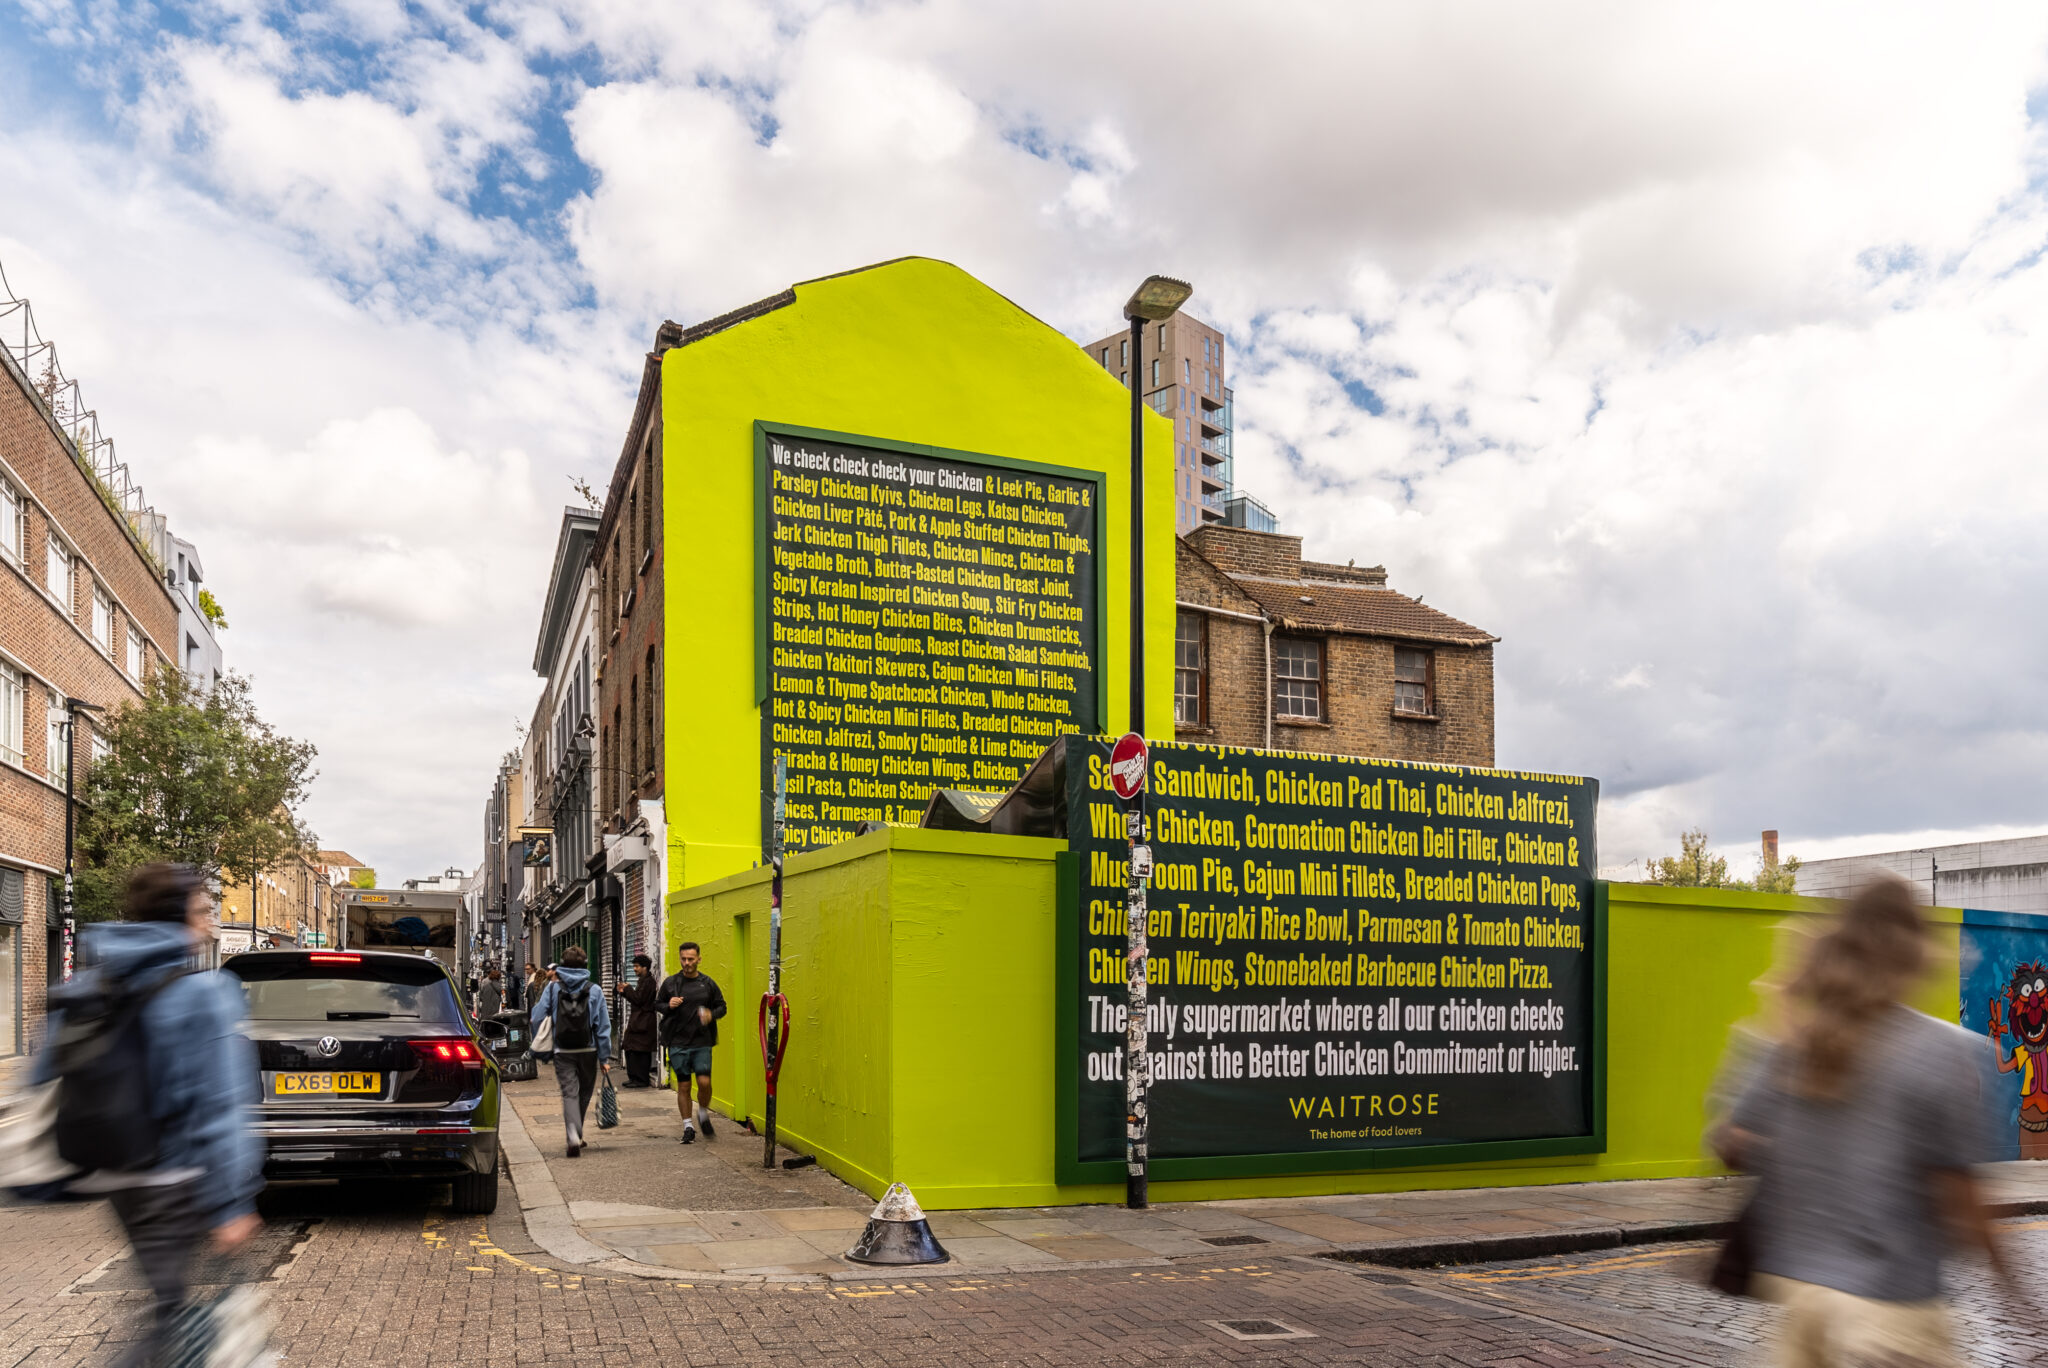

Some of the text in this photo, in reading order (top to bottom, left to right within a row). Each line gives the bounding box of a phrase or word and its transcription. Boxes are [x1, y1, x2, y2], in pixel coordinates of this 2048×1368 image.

[772, 443, 1090, 507] We check check check your Chicken & Leek Pie, Garlic &
[773, 469, 1068, 529] Parsley Chicken Kyivs, Chicken Legs, Katsu Chicken,
[773, 495, 1091, 555] Chicken Liver Pâté, Pork & Apple Stuffed Chicken Thighs,
[773, 520, 1075, 575] Jerk Chicken Thigh Fillets, Chicken Mince, Chicken &
[773, 545, 1073, 599] Vegetable Broth, Butter-Basted Chicken Breast Joint,
[773, 571, 1083, 622] Spicy Keralan Inspired Chicken Soup, Stir Fry Chicken
[773, 596, 1082, 647] Strips, Hot Honey Chicken Bites, Chicken Drumsticks,
[773, 646, 1077, 693] Chicken Yakitori Skewers, Cajun Chicken Mini Fillets,
[774, 621, 1091, 672] Breaded Chicken Goujons, Roast Chicken Salad Sandwich,
[773, 697, 1053, 737] Hot & Spicy Chicken Mini Fillets, Breaded Chicken
[774, 672, 1071, 716] Lemon & Thyme Spatchcock Chicken, Whole Chicken,
[773, 722, 1007, 757] Chicken Jalfrezi, Smoky Chipotle & Lime
[841, 752, 970, 781] Honey Chicken Wings,
[1154, 760, 1260, 806] Sandwich,
[1266, 769, 1342, 807] Chicken
[1348, 775, 1382, 810] Pad
[1387, 778, 1431, 818] Thai,
[1436, 783, 1504, 820] Chicken
[1508, 790, 1574, 829] Jalfrezi,
[1157, 807, 1240, 851] Chicken,
[1245, 813, 1345, 852] Coronation
[1350, 820, 1418, 857] Chicken
[1423, 825, 1454, 859] Deli
[1458, 828, 1501, 866] Filler,
[1506, 831, 1564, 866] Chicken
[1568, 836, 1579, 867] &
[1203, 857, 1580, 913] Pie, Cajun Mini Fillets, Breaded Chicken Pops,
[1178, 903, 1584, 951] Teriyaki Rice Bowl, Parmesan & Tomato Chicken,
[1176, 950, 1552, 992] Wings, Stonebaked Barbecue Chicken Pizza.
[1088, 996, 1563, 1040] The supermarket where all our chicken checks
[285, 1074, 373, 1090] CX69 OLW
[1087, 1039, 1578, 1081] out the Better Chicken Commitment or higher.
[1289, 1093, 1438, 1119] WAITROSE
[1310, 1125, 1421, 1139] The home of food lovers
